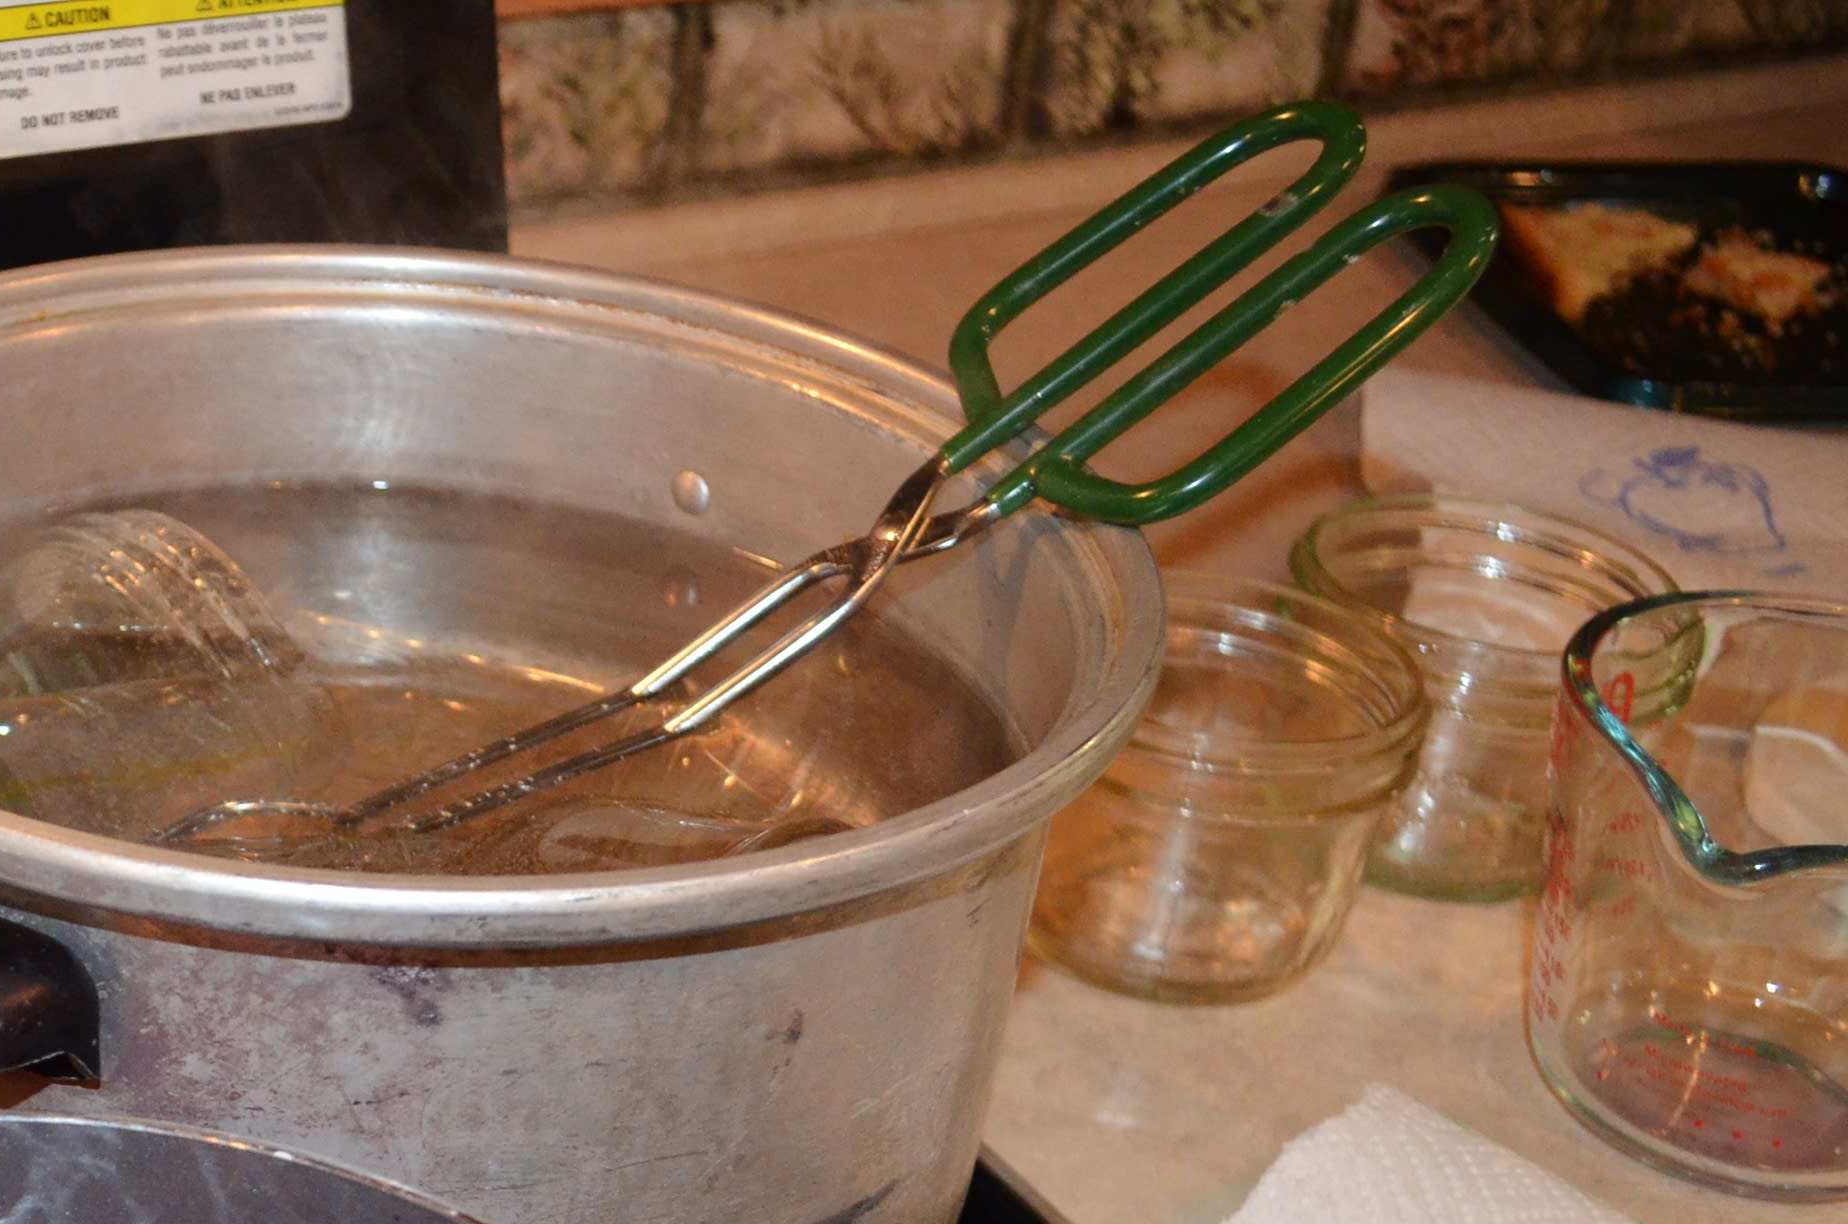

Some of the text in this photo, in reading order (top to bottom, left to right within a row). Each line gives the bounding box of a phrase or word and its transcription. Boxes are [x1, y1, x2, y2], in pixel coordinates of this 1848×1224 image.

[45, 6, 110, 28] CAUTION
[20, 48, 32, 59] to
[36, 43, 72, 57] unlock
[77, 40, 105, 53] cover
[109, 35, 144, 48] before
[27, 67, 49, 77] may
[54, 59, 86, 74] result
[90, 59, 99, 70] in
[104, 54, 147, 69] product
[200, 83, 295, 104] NE PAS ENLEVER
[21, 106, 119, 129] DO NOT REMOVE
